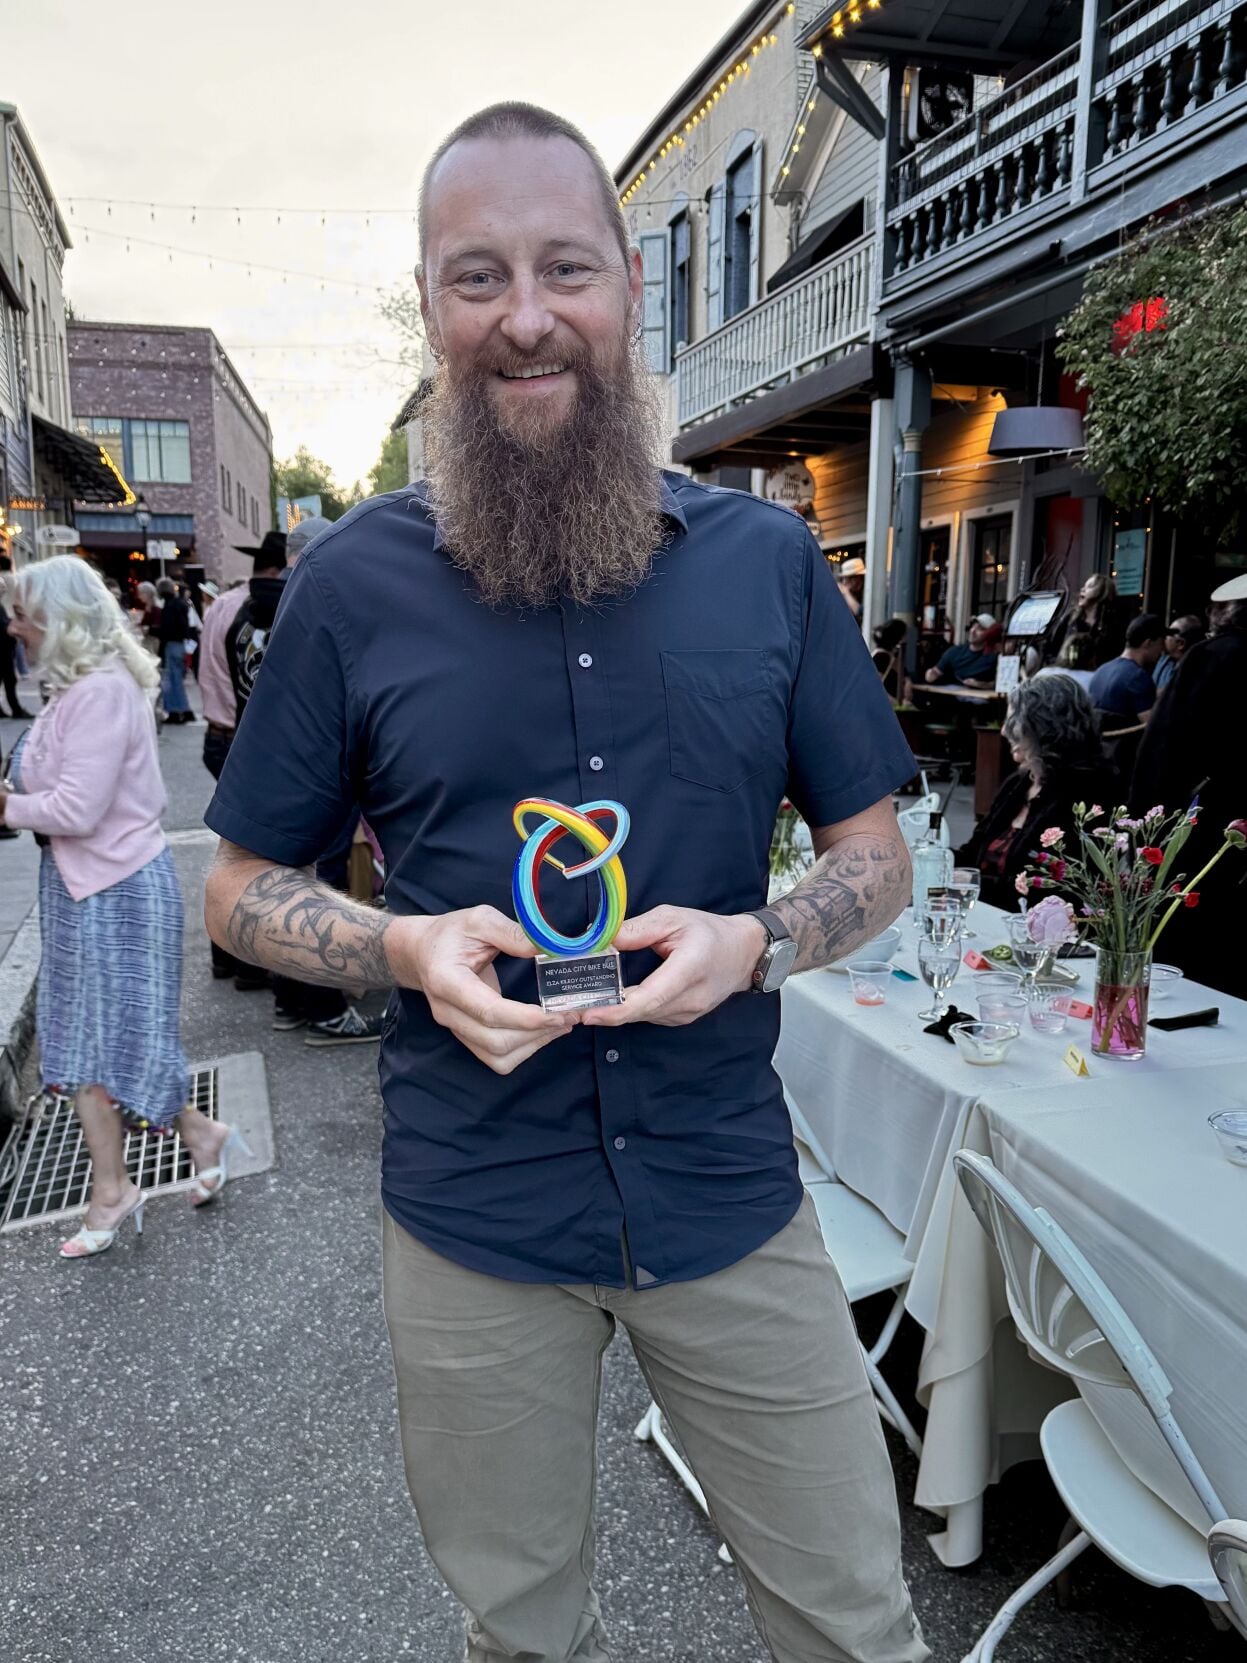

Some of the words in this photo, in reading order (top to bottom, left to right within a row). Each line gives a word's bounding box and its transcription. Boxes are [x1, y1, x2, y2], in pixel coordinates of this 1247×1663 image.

[545, 968, 572, 976] NEVADA
[573, 965, 587, 973] CITY
[588, 963, 601, 971] BIKE
[579, 974, 616, 982] OUTSTANDING
